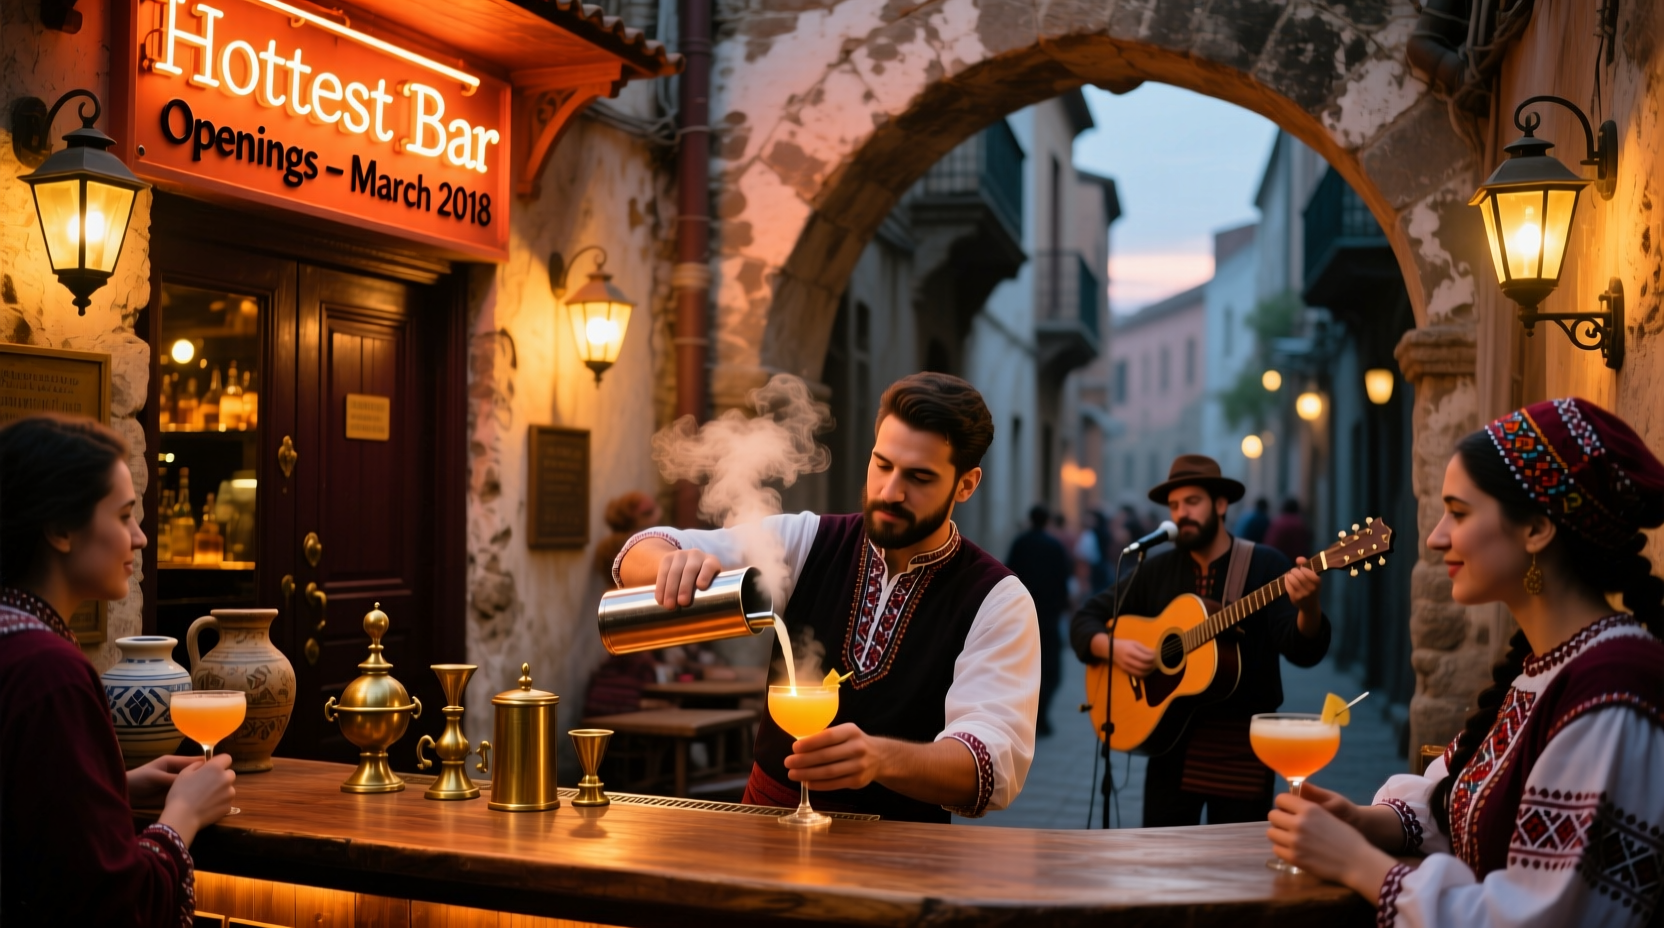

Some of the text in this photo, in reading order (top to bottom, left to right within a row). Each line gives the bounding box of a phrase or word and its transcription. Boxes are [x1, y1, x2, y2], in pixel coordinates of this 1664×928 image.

[155, 0, 500, 173] Hottest Bar
[160, 98, 319, 187] Openings
[350, 154, 432, 212] March
[437, 181, 492, 227] 2018
